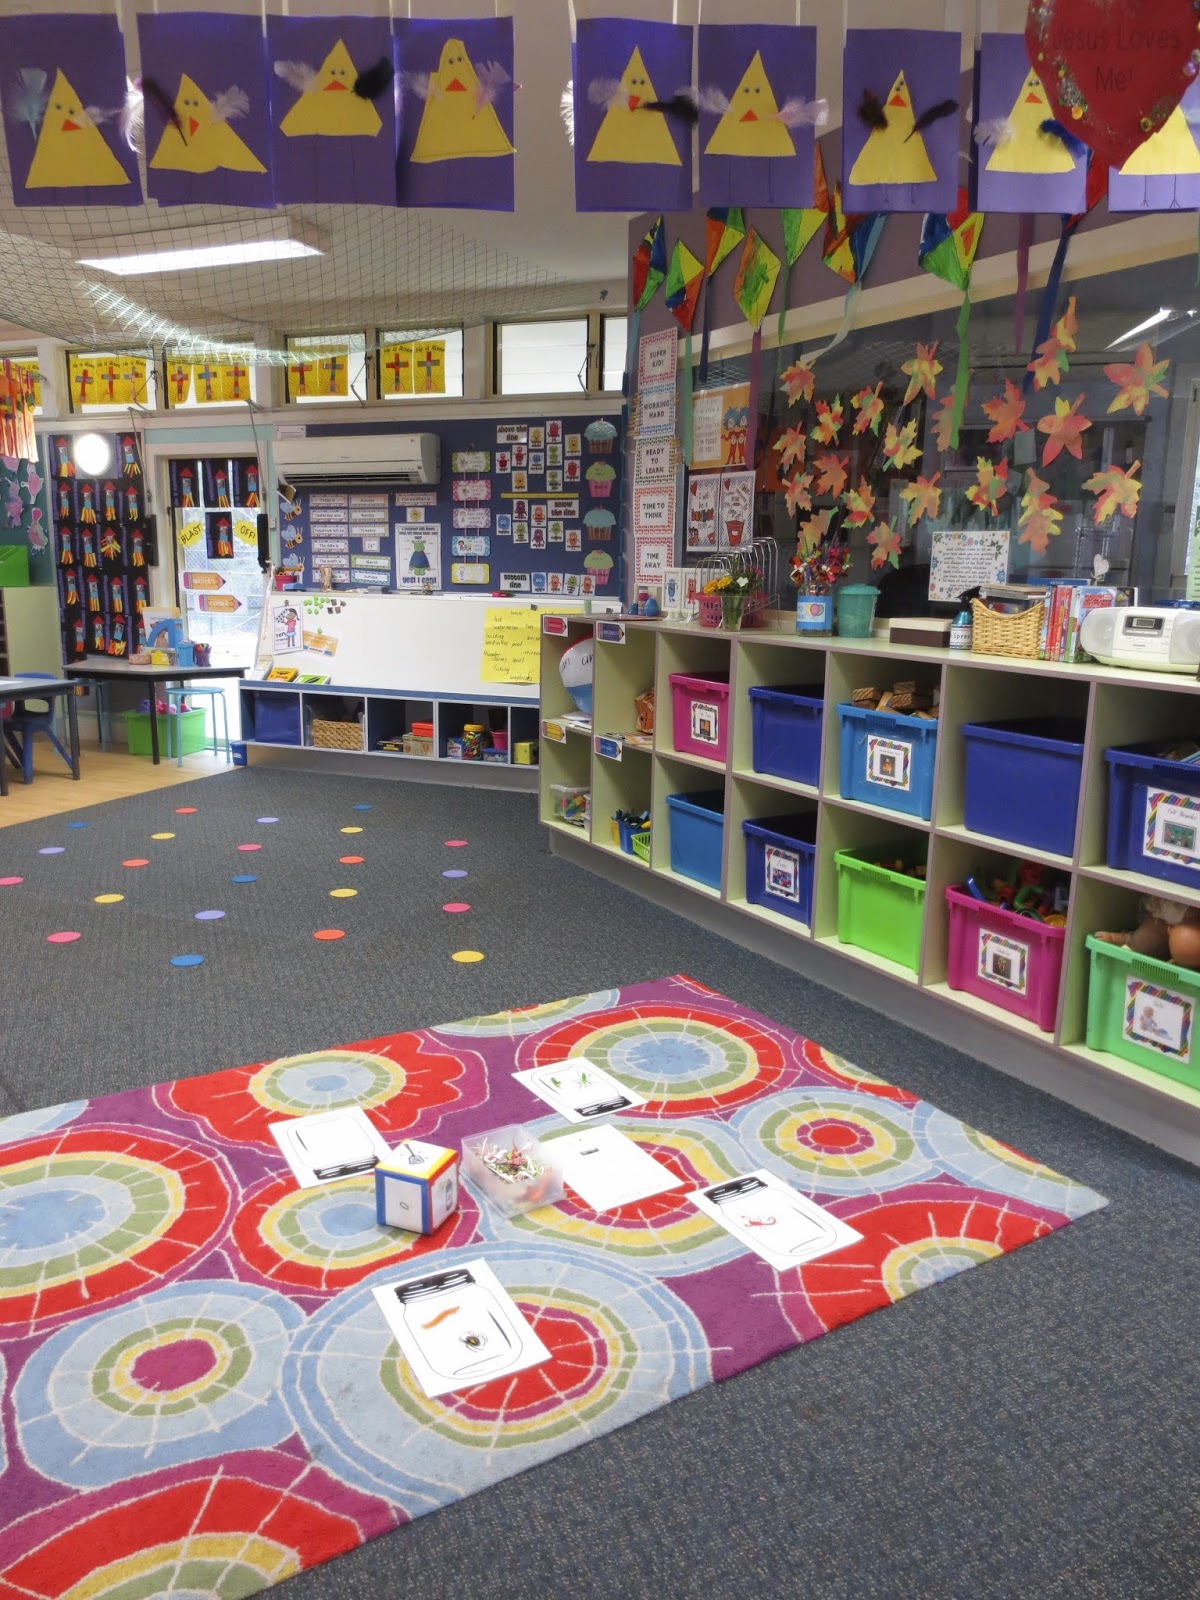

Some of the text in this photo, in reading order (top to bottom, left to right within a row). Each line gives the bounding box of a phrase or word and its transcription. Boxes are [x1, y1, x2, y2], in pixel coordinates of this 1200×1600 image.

[1053, 23, 1180, 51] Jesus Loves
[1095, 63, 1134, 94] Me!
[649, 349, 667, 359] SUPER
[652, 360, 664, 369] KID!
[643, 399, 670, 410] WORKING
[649, 411, 665, 420] HARD
[506, 433, 519, 441] line
[645, 447, 665, 456] READY
[651, 457, 659, 465] TO
[645, 466, 664, 475] LEARN
[657, 502, 666, 510] TO
[563, 508, 576, 516] line
[644, 511, 662, 519] THINK
[180, 524, 202, 545] BLAST
[240, 525, 256, 542] OFF!
[646, 552, 659, 560] TIME
[644, 561, 661, 569] AWAY
[953, 632, 970, 641] Spray
